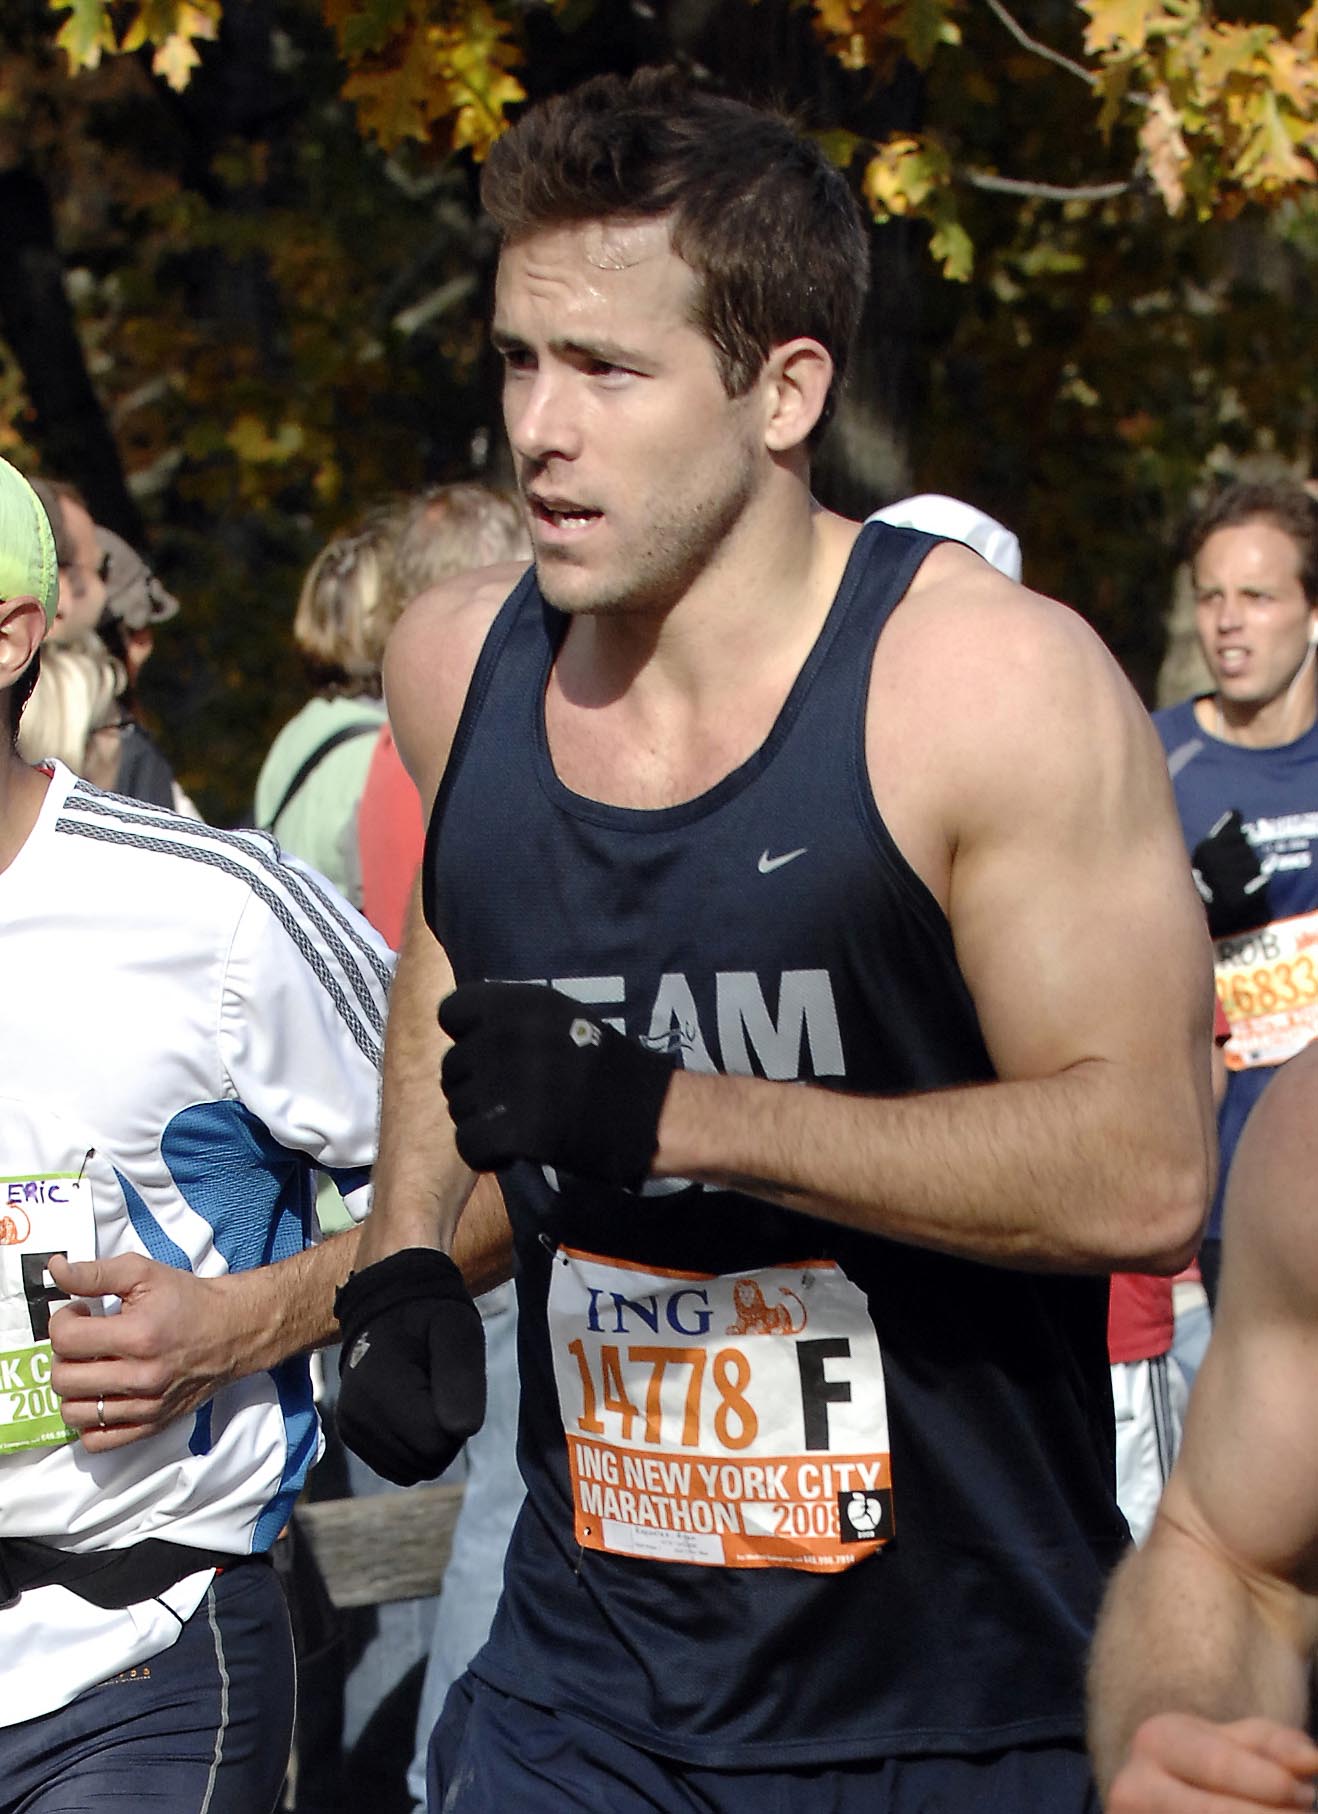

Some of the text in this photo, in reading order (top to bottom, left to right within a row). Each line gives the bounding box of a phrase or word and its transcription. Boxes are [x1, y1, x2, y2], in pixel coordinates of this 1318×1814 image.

[1216, 955, 1318, 1014] 6833
[485, 968, 846, 1080] AM
[586, 1288, 714, 1336] ING
[568, 1338, 852, 1451] 14778 F
[576, 1443, 881, 1500] ING NEW YORK CITY
[579, 1480, 740, 1535] MARATHON
